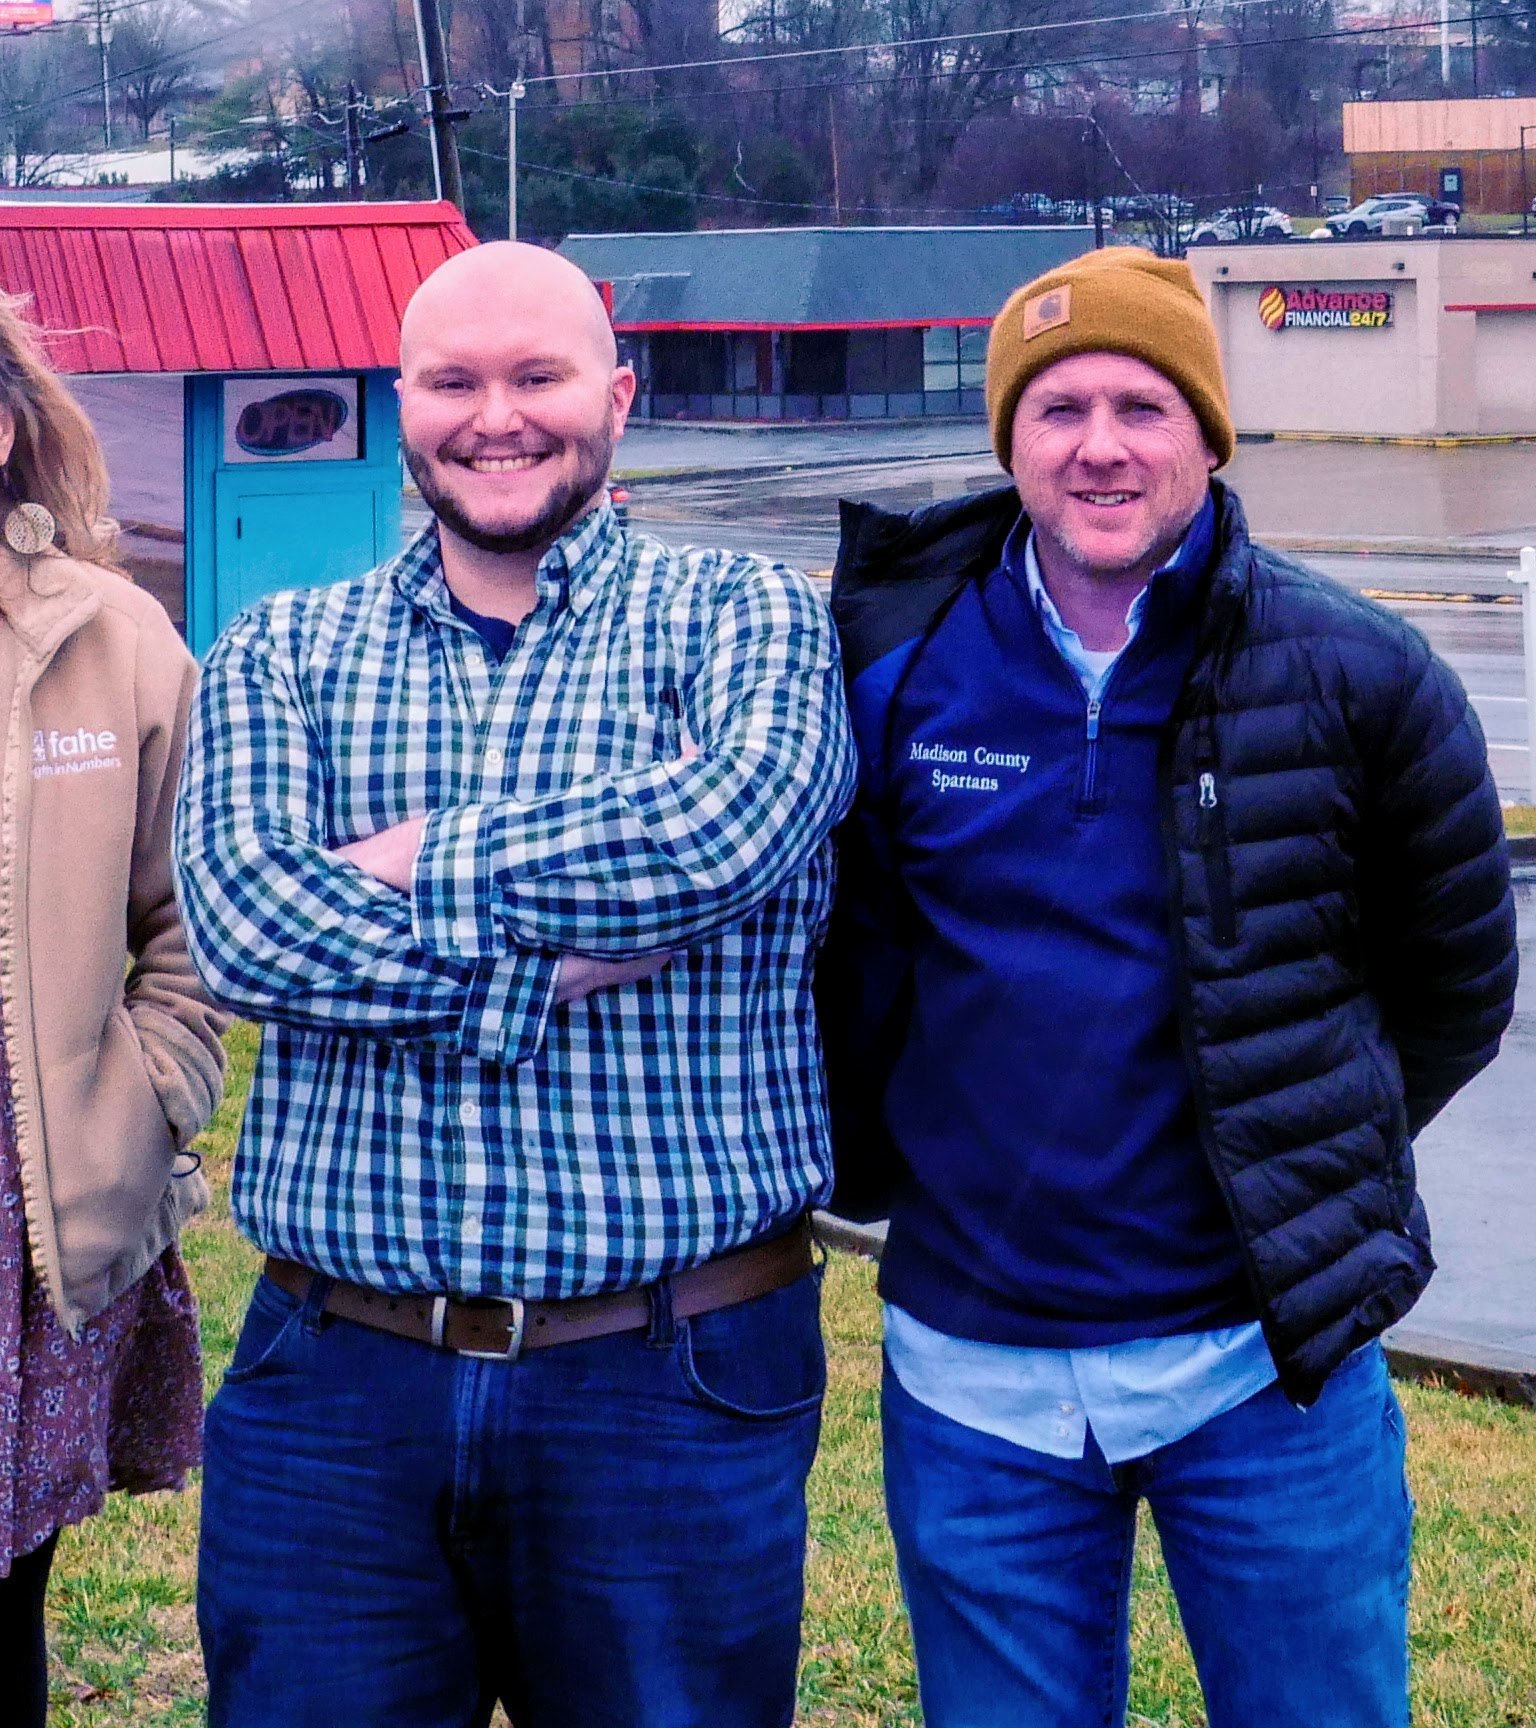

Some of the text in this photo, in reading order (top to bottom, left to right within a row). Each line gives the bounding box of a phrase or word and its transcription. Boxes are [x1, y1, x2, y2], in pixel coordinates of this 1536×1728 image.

[1286, 288, 1389, 311] Advance
[1285, 311, 1387, 327] FINANCIAL 24/7
[236, 398, 337, 445] OPEN
[49, 728, 118, 758] fahe
[65, 756, 122, 772] Numbers
[909, 742, 1031, 773] Madison County
[931, 768, 999, 793] Spartans
